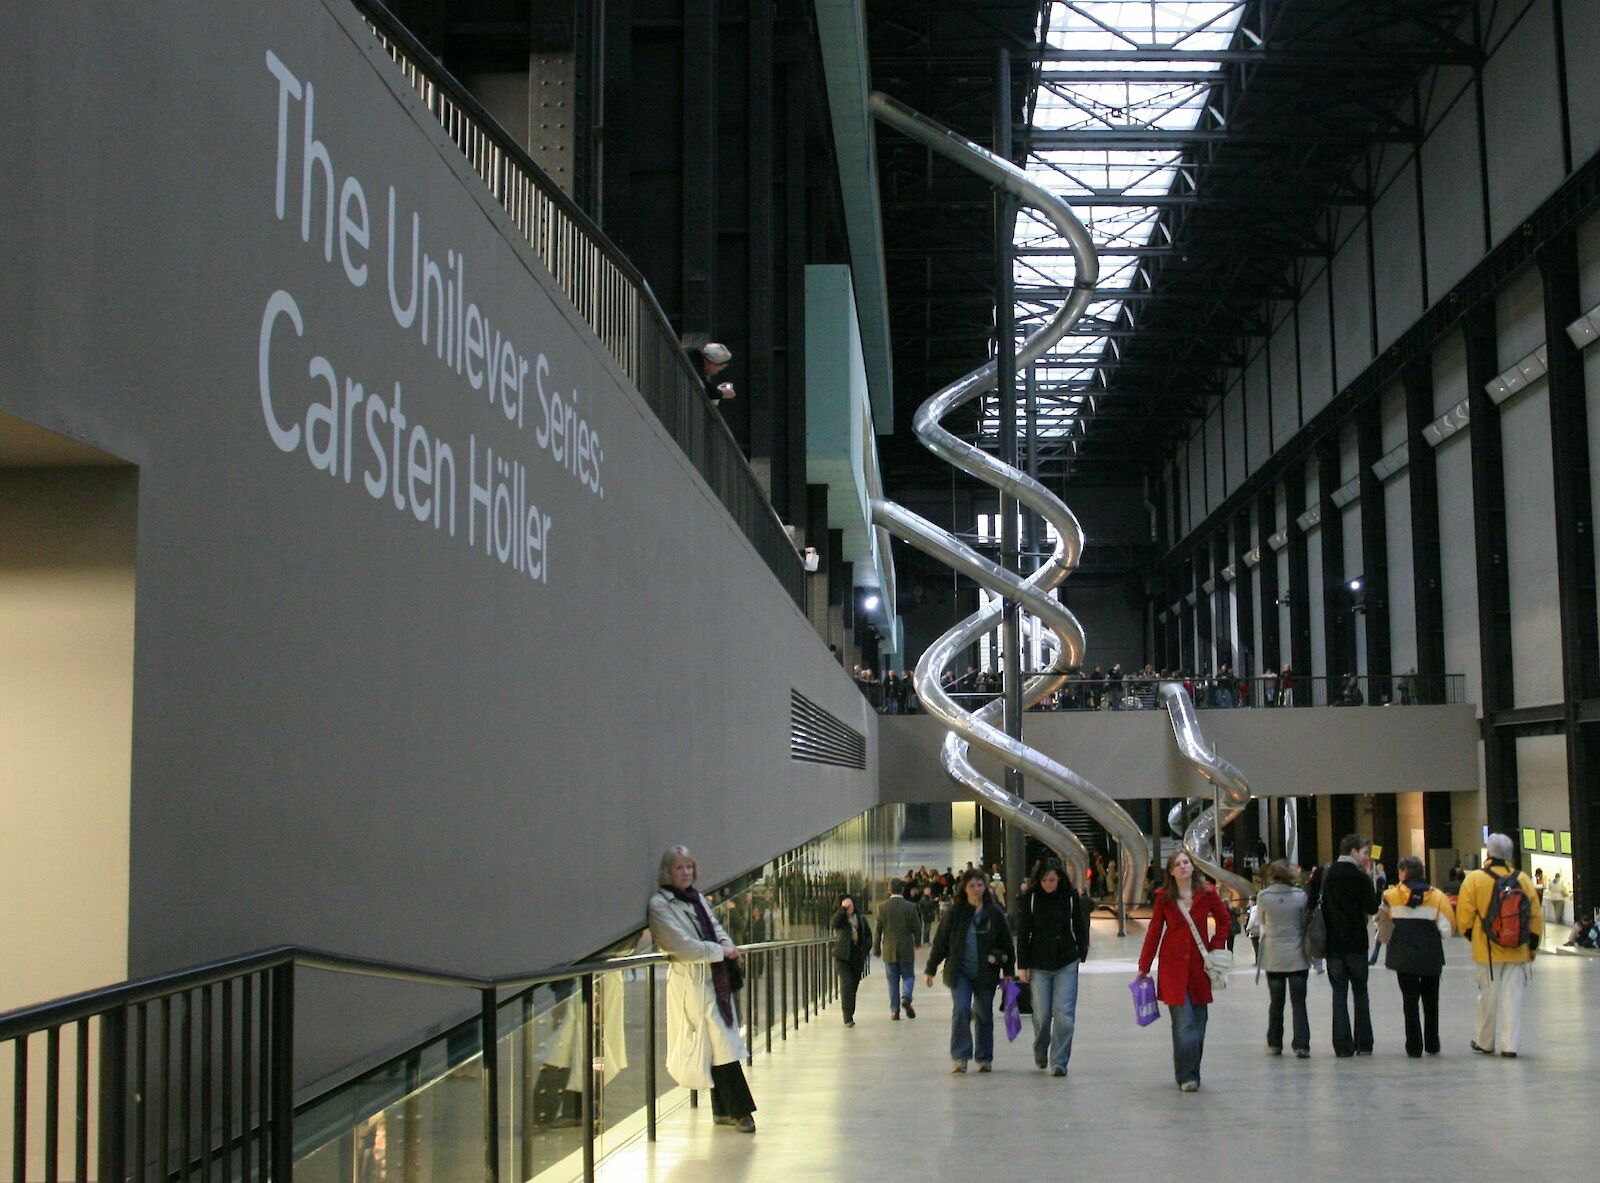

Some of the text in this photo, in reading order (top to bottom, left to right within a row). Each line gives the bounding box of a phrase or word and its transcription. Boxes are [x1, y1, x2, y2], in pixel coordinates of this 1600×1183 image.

[259, 289, 552, 585] Carsten Höller
[266, 50, 604, 499] The Unilever Series:
